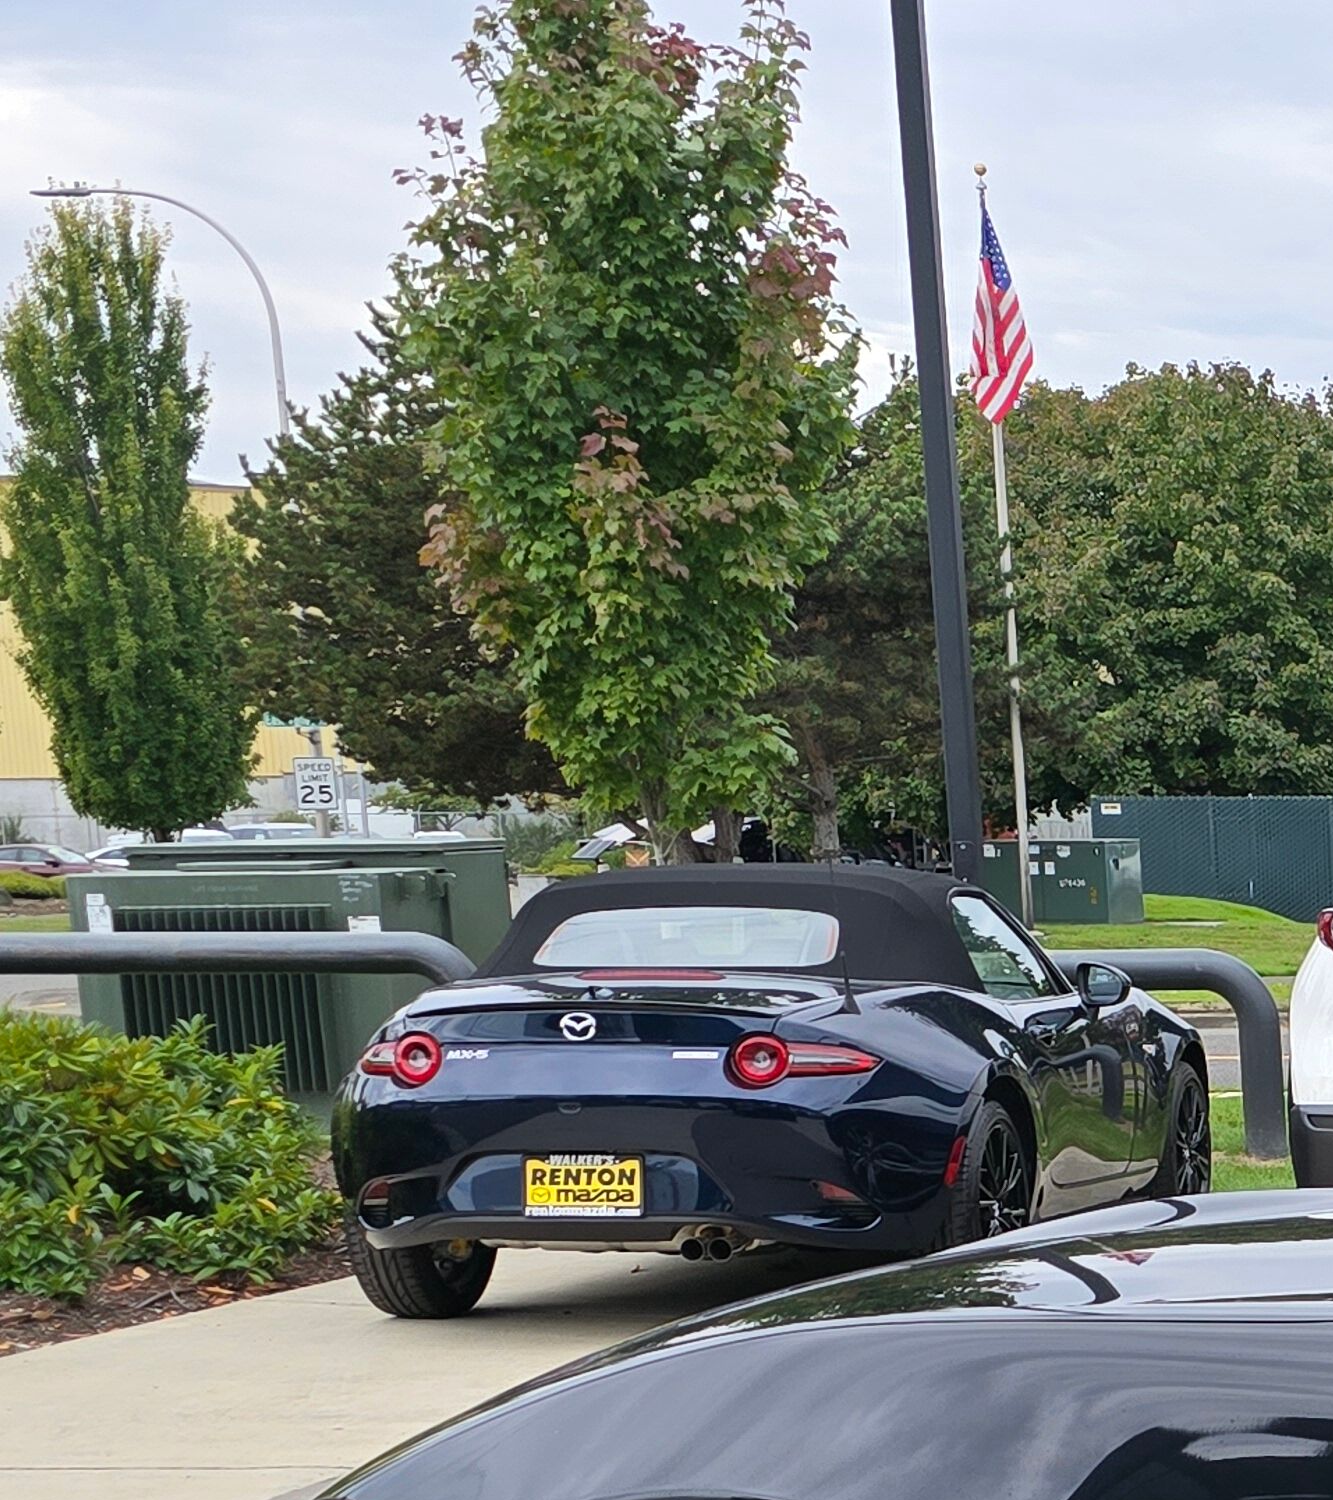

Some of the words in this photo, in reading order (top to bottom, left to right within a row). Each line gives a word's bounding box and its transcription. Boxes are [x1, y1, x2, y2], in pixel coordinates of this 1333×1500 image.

[297, 763, 331, 772] SPEED
[302, 774, 328, 782] LIMIT
[300, 785, 333, 804] 25
[446, 1049, 490, 1060] MX-5
[549, 1154, 616, 1167] WALKER'S
[531, 1168, 636, 1186] RENTON
